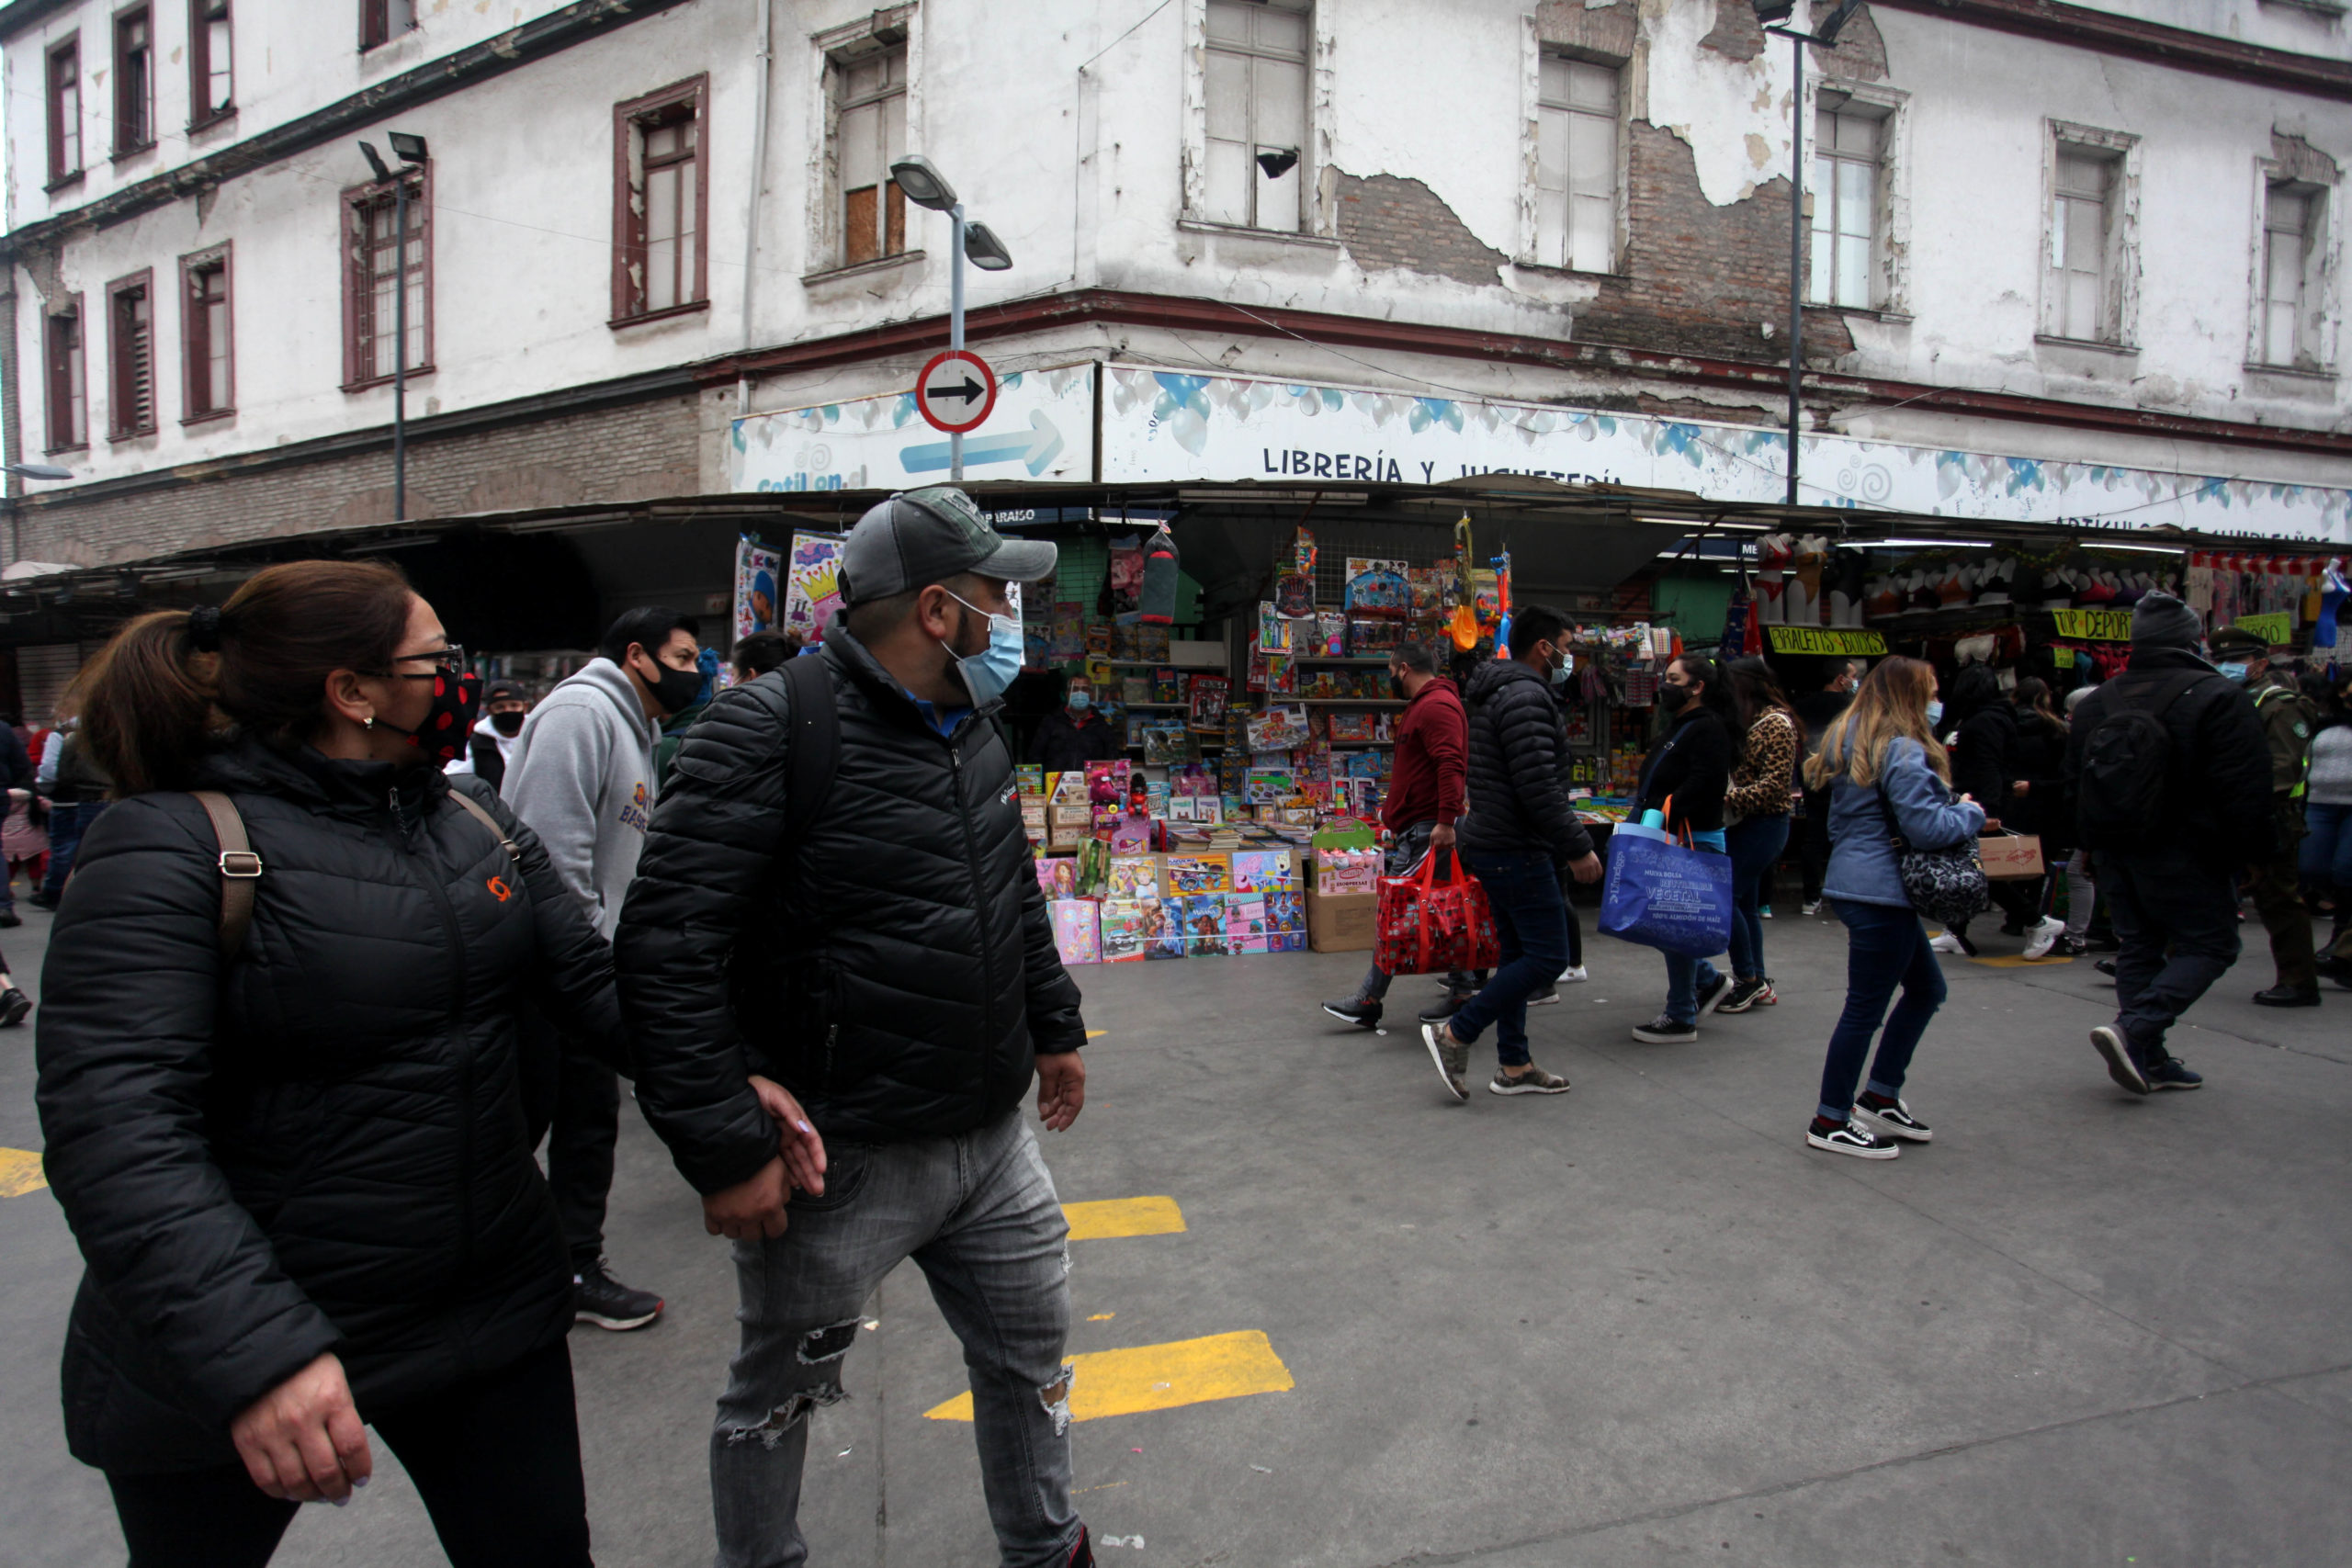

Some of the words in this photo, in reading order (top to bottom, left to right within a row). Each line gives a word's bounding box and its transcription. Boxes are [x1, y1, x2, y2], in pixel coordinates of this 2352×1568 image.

[1263, 447, 1403, 483] LIBRERÍA
[1420, 461, 1435, 484] Y
[2054, 611, 2077, 635] TOP
[1645, 886, 1702, 903] VEGETAL
